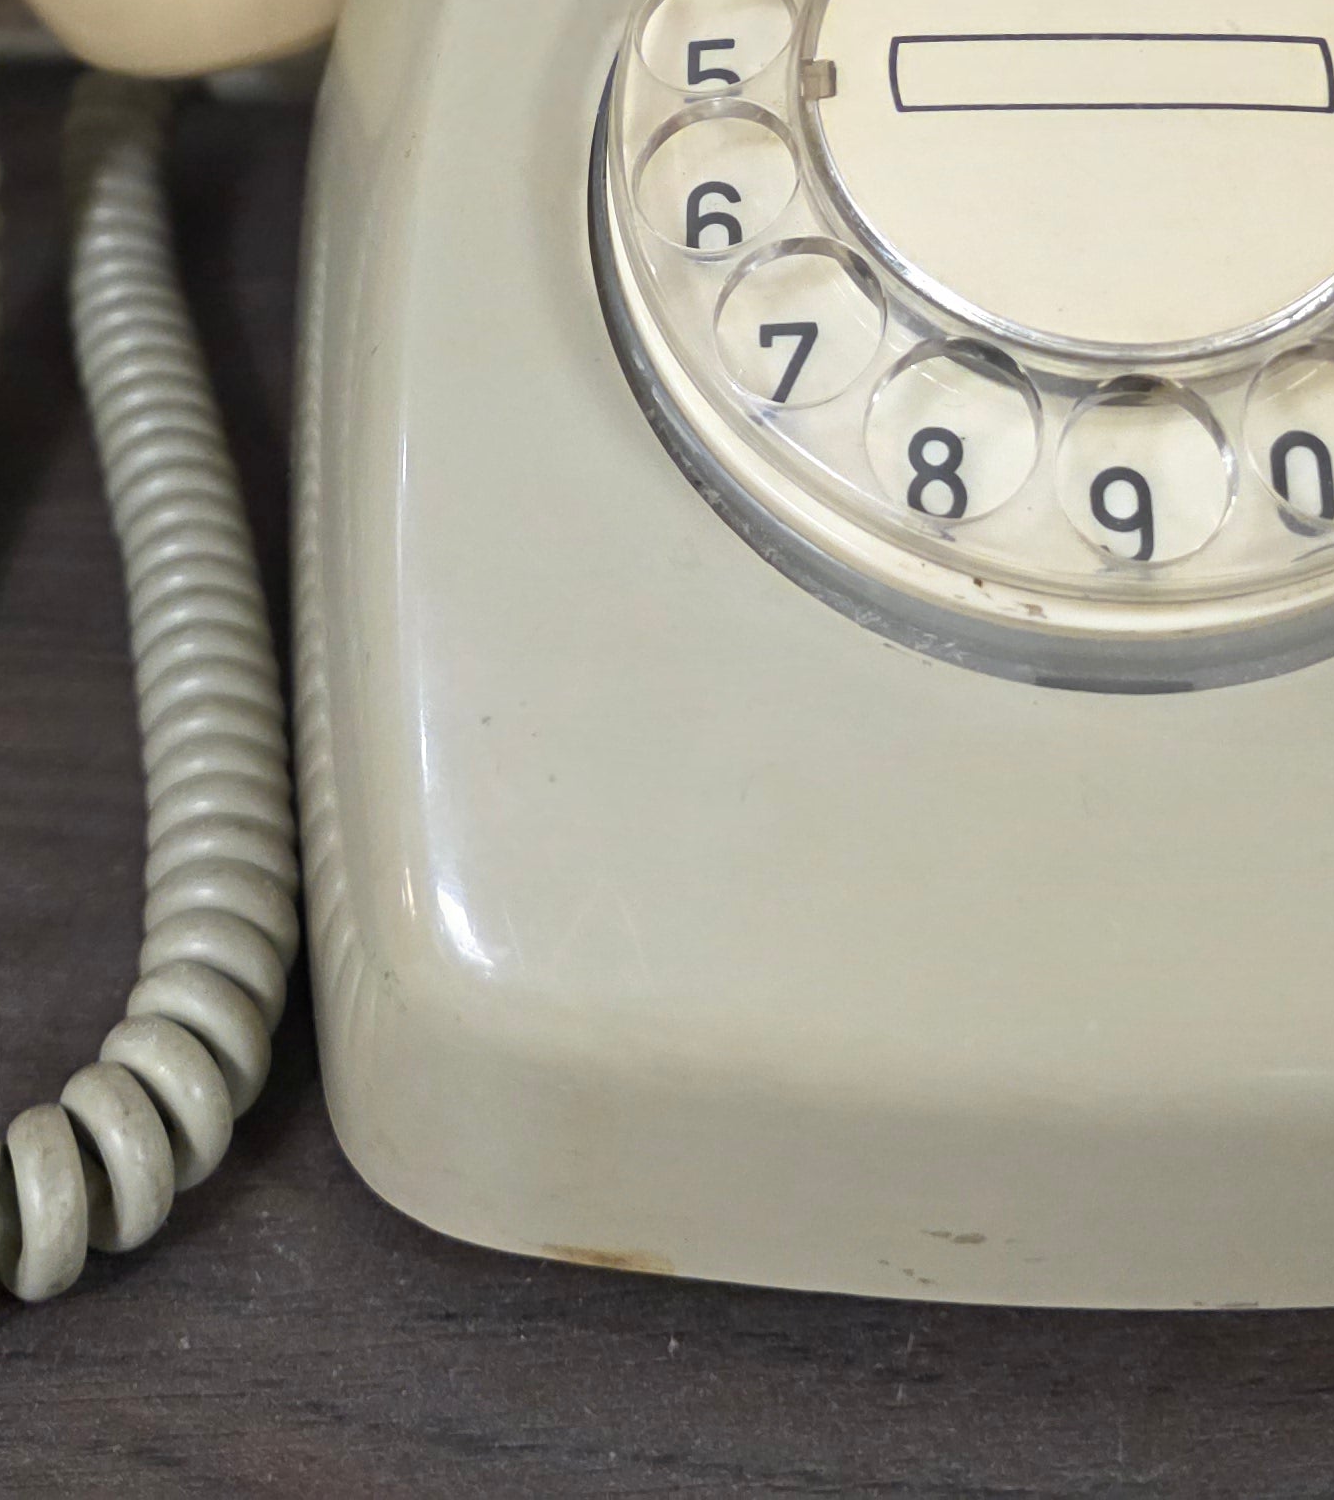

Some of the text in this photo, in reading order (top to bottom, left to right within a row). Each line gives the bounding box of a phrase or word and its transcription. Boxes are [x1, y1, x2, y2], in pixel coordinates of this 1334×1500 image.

[685, 38, 742, 98] 5
[686, 181, 743, 258] 6
[759, 322, 818, 407] 7
[906, 426, 968, 520] 8
[1089, 465, 1155, 564] 9
